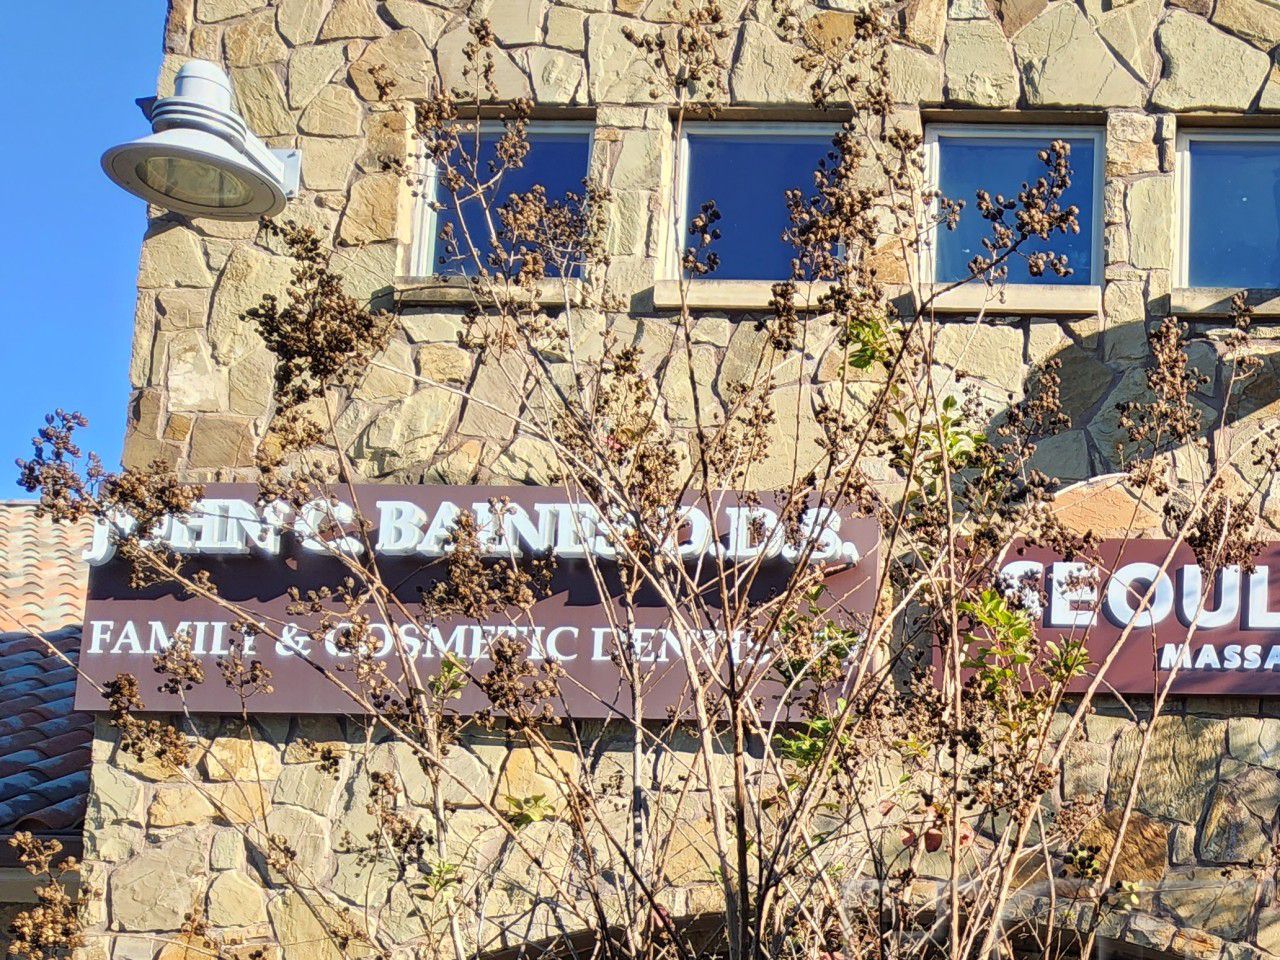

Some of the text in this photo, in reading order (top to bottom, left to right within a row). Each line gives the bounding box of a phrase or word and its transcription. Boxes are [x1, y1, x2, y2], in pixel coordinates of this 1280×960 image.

[87, 620, 868, 665] FAMILY & COSMETIC DENTIS
